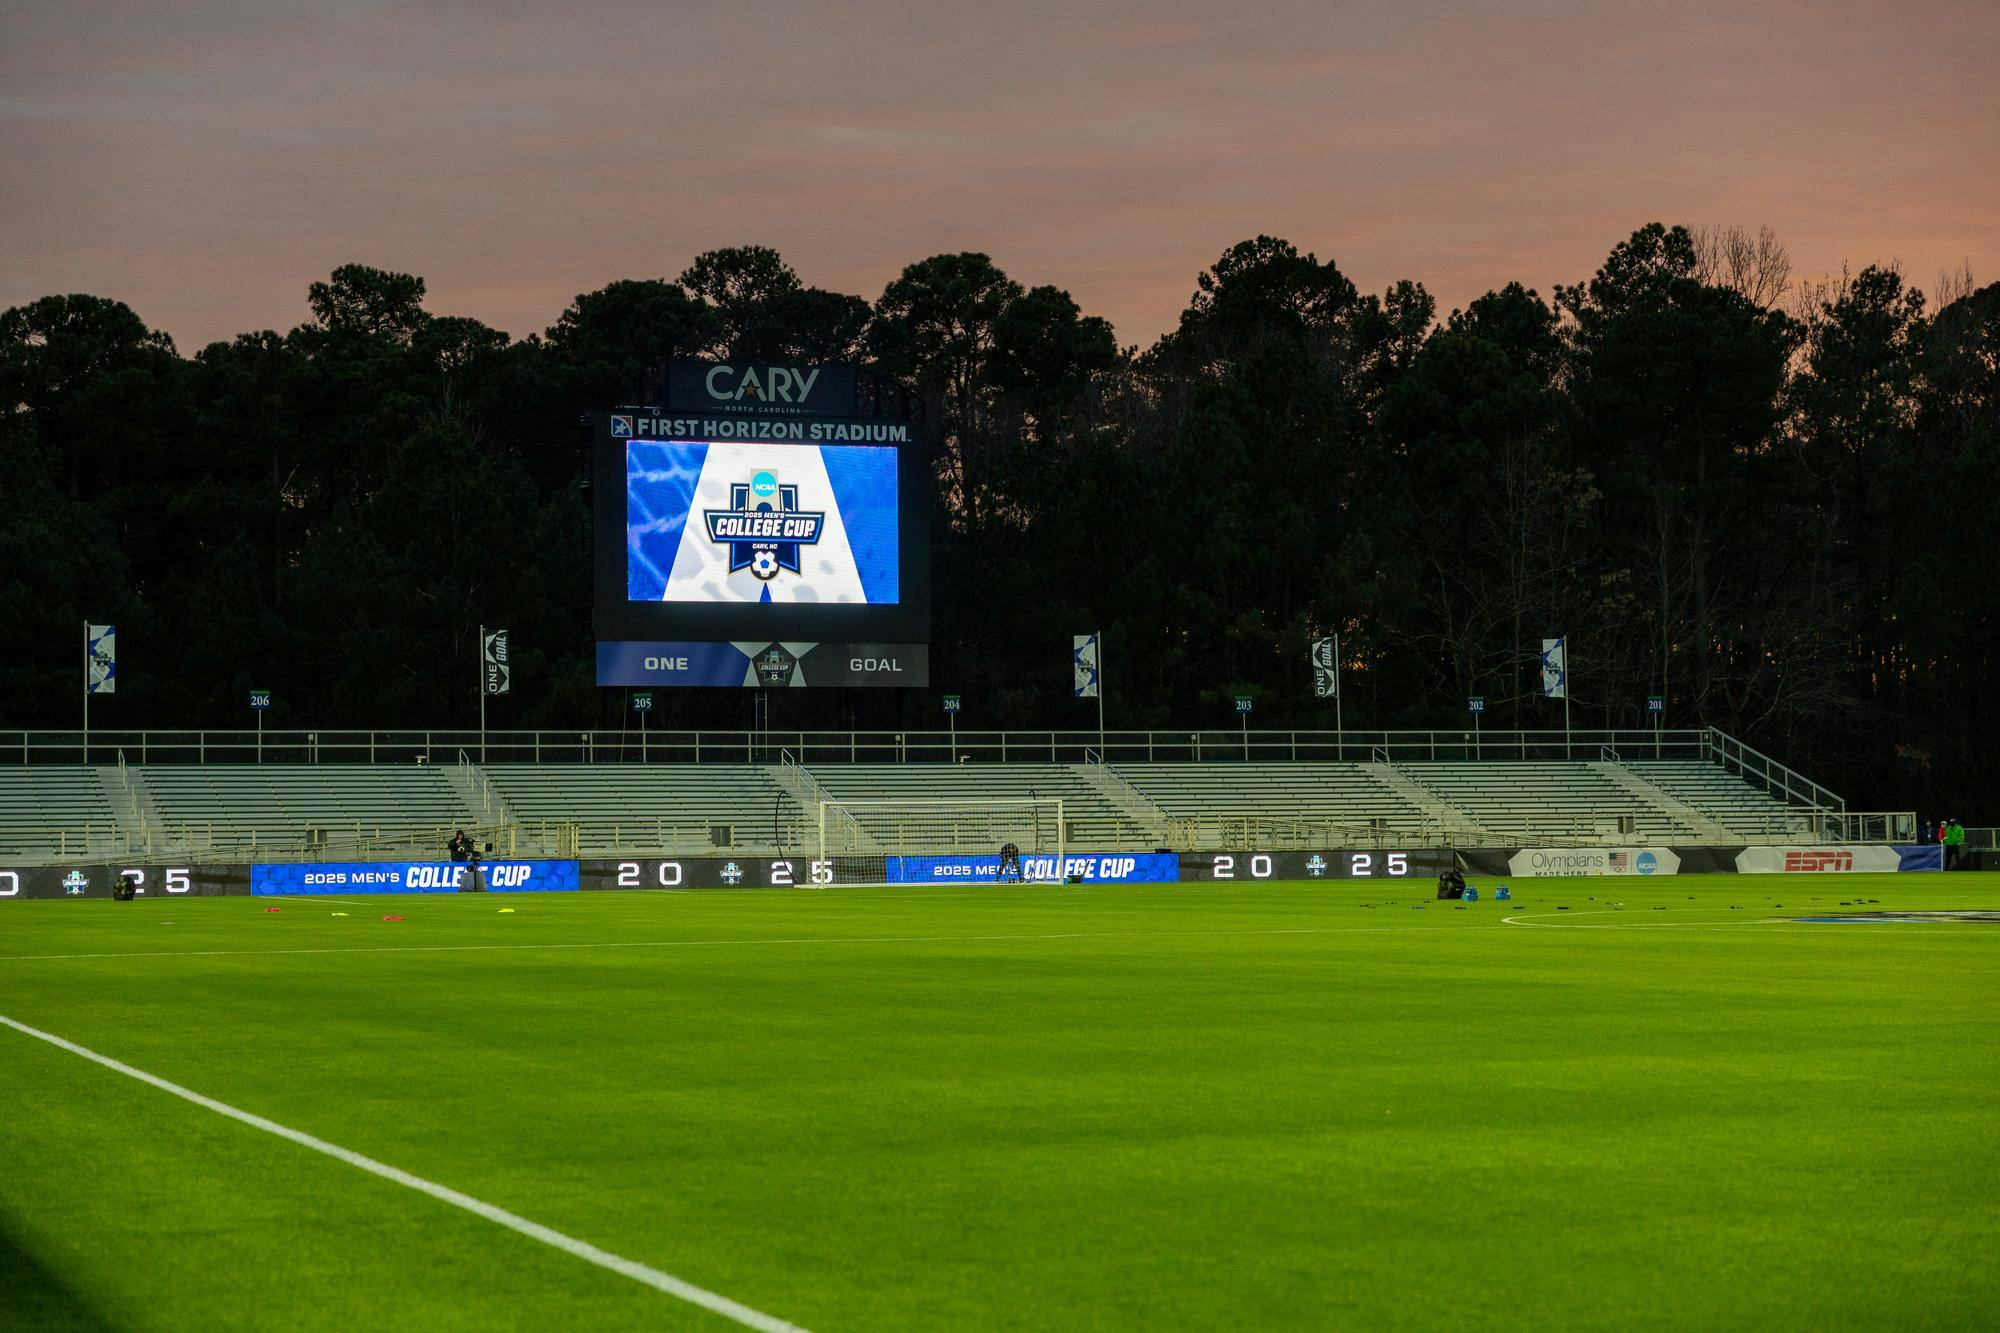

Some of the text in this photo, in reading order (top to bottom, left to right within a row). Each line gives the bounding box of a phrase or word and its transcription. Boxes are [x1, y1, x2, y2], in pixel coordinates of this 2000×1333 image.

[705, 365, 820, 403] CARY
[758, 406, 801, 414] CAROLINA
[637, 418, 907, 442] FIRST HORIZON STADIUM
[755, 483, 776, 491] NCAA
[715, 518, 783, 537] COLLEGE
[496, 636, 507, 662] GOAL
[1321, 642, 1332, 667] GOAL
[644, 657, 903, 672] ONE GOAL
[489, 664, 498, 692] ONE
[1316, 669, 1325, 695] ONE
[251, 695, 270, 706] 206
[634, 698, 652, 708] 205
[944, 699, 960, 709] 204
[1236, 700, 1252, 710] 203
[1469, 700, 1484, 710] 202
[1649, 700, 1662, 710] 201
[933, 866, 972, 876] 2025
[1023, 858, 1097, 879] COLLEGE
[1099, 858, 1136, 878] CUP
[1531, 852, 1603, 872] Olympians
[1784, 851, 1853, 872] ESPN
[304, 865, 532, 888] 2025 MEN'S COLLE CUP
